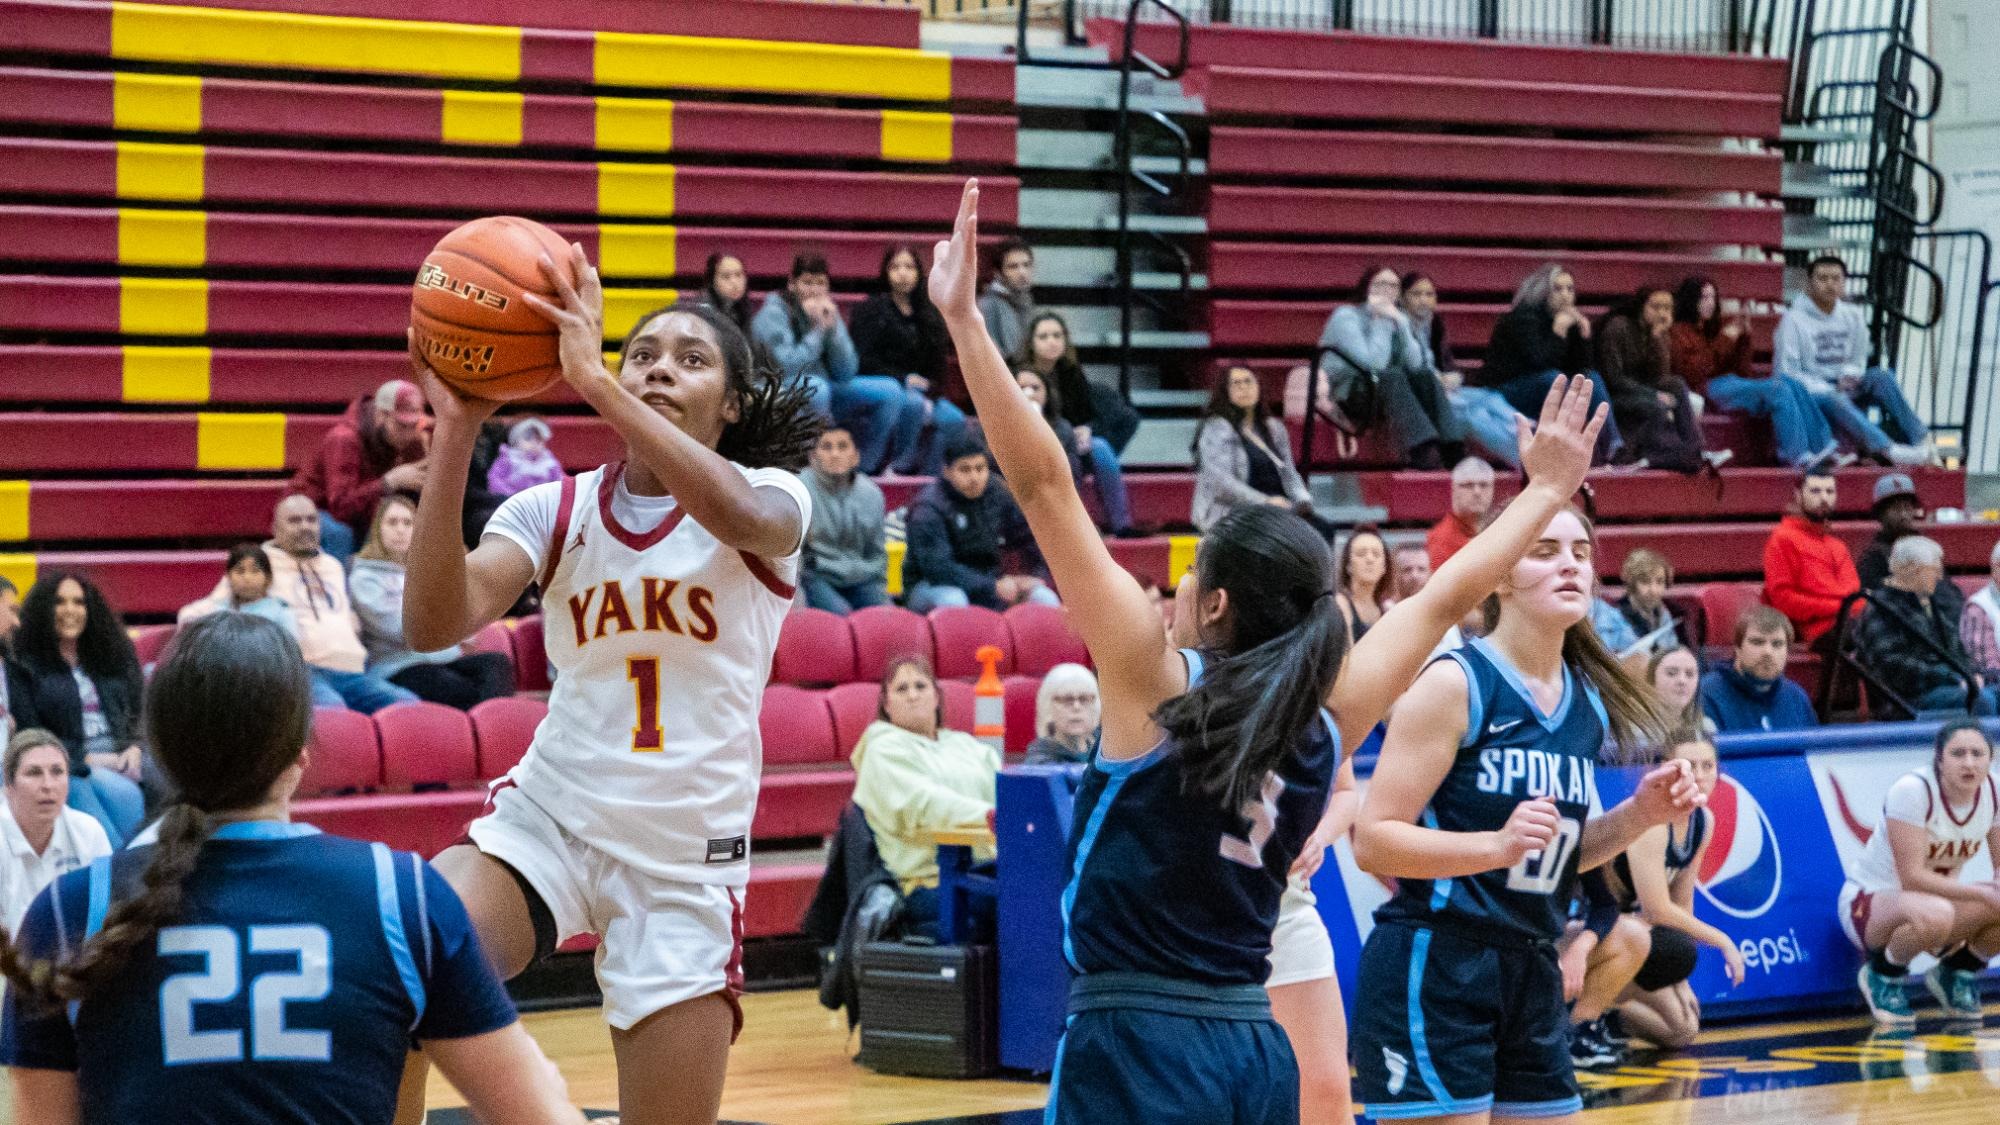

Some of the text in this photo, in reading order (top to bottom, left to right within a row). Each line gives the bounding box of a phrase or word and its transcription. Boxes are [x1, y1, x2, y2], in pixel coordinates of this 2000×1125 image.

[567, 576, 719, 648] YAKS
[626, 655, 664, 753] 1
[1476, 747, 1595, 807] SPOKAN
[1740, 927, 1803, 975] epsi
[157, 923, 333, 1066] 22
